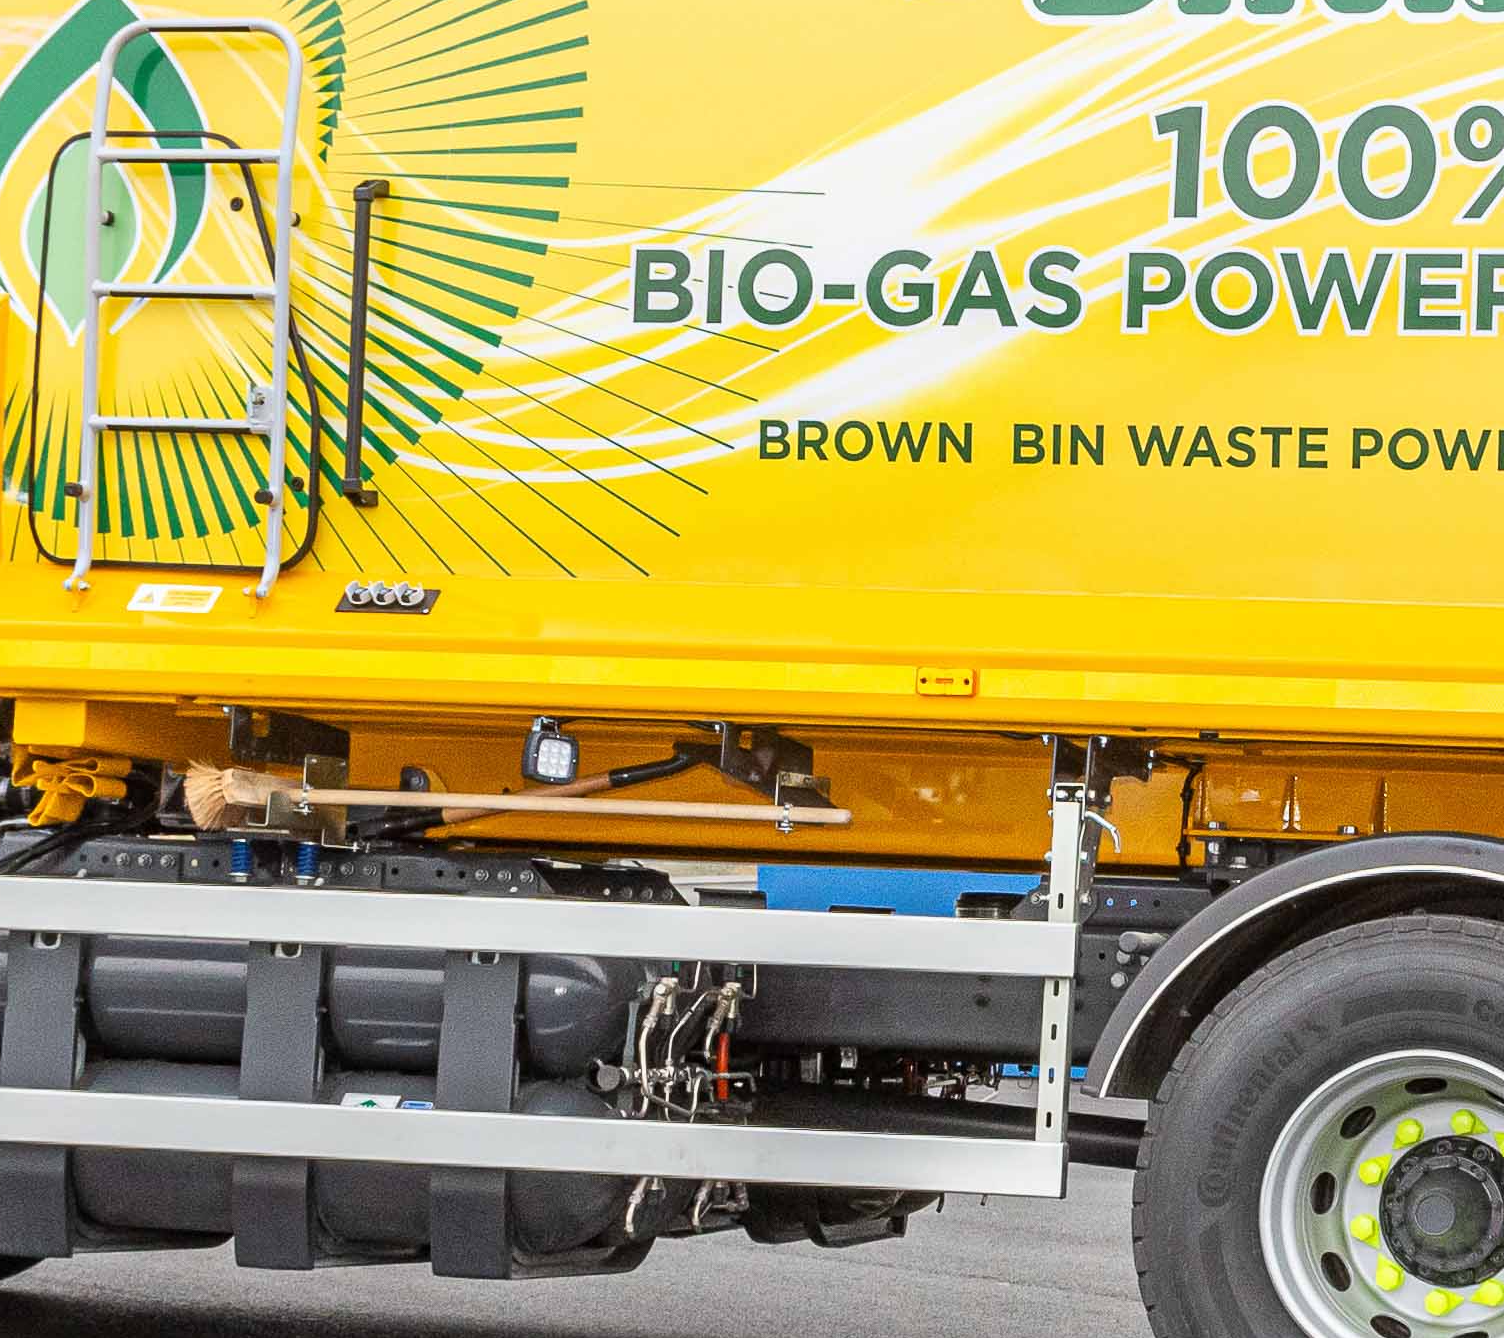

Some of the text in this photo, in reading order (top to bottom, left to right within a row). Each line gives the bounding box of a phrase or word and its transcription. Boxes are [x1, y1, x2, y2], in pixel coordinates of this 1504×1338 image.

[633, 248, 1084, 328] BIO-GAS
[758, 419, 973, 463] BROWN
[1012, 423, 1105, 466] BIN
[1127, 424, 1329, 469] WASTE
